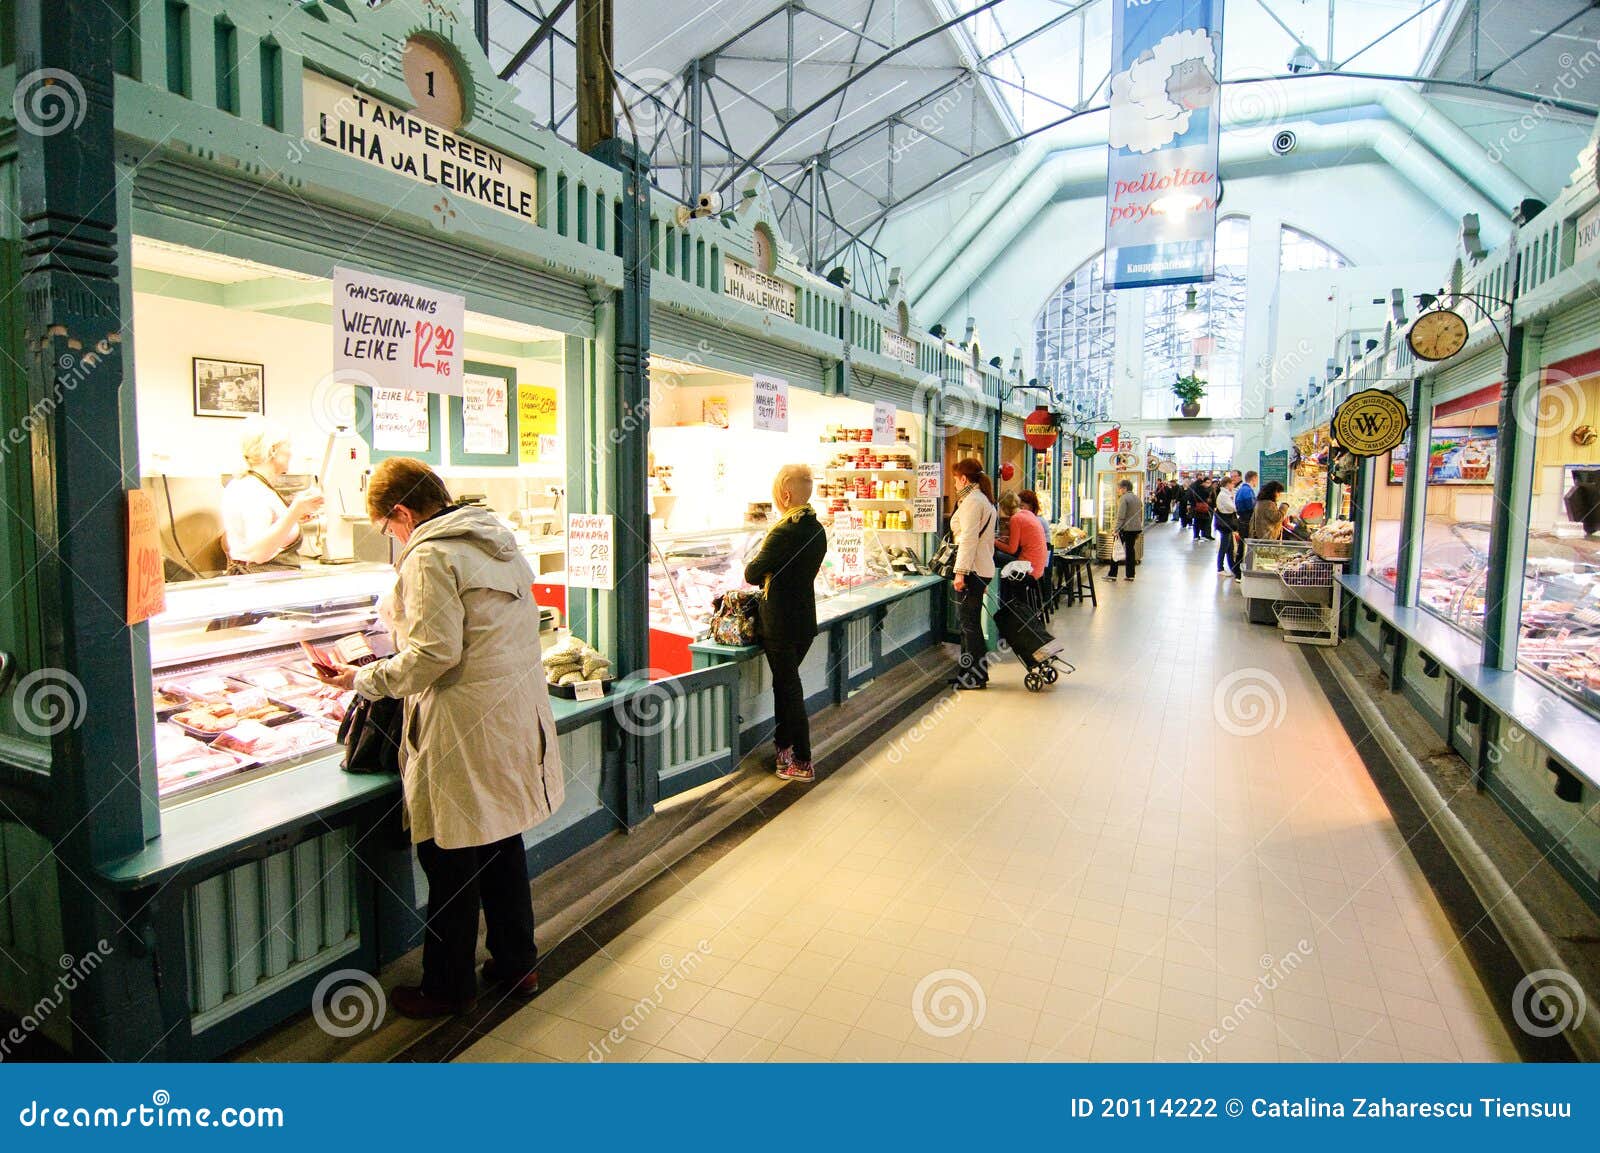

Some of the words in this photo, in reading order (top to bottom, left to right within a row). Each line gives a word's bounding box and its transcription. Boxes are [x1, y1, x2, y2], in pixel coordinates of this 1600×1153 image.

[425, 71, 435, 98] 1
[352, 93, 502, 174] TAMPEREEN
[320, 112, 384, 165] LIHA
[390, 152, 418, 177] JA
[422, 153, 531, 218] LEIKKELE
[1114, 167, 1214, 202] pellolta
[734, 262, 784, 295] TAMPEREEN
[345, 282, 437, 314] PAISTOVALMIS
[723, 276, 745, 300] LIHA
[757, 289, 795, 318] LEIKKELE
[342, 308, 411, 339] WIENIN-
[343, 337, 398, 361] LEIKE
[413, 320, 435, 368] 12
[436, 359, 451, 377] KG
[376, 389, 402, 401] LEIKE
